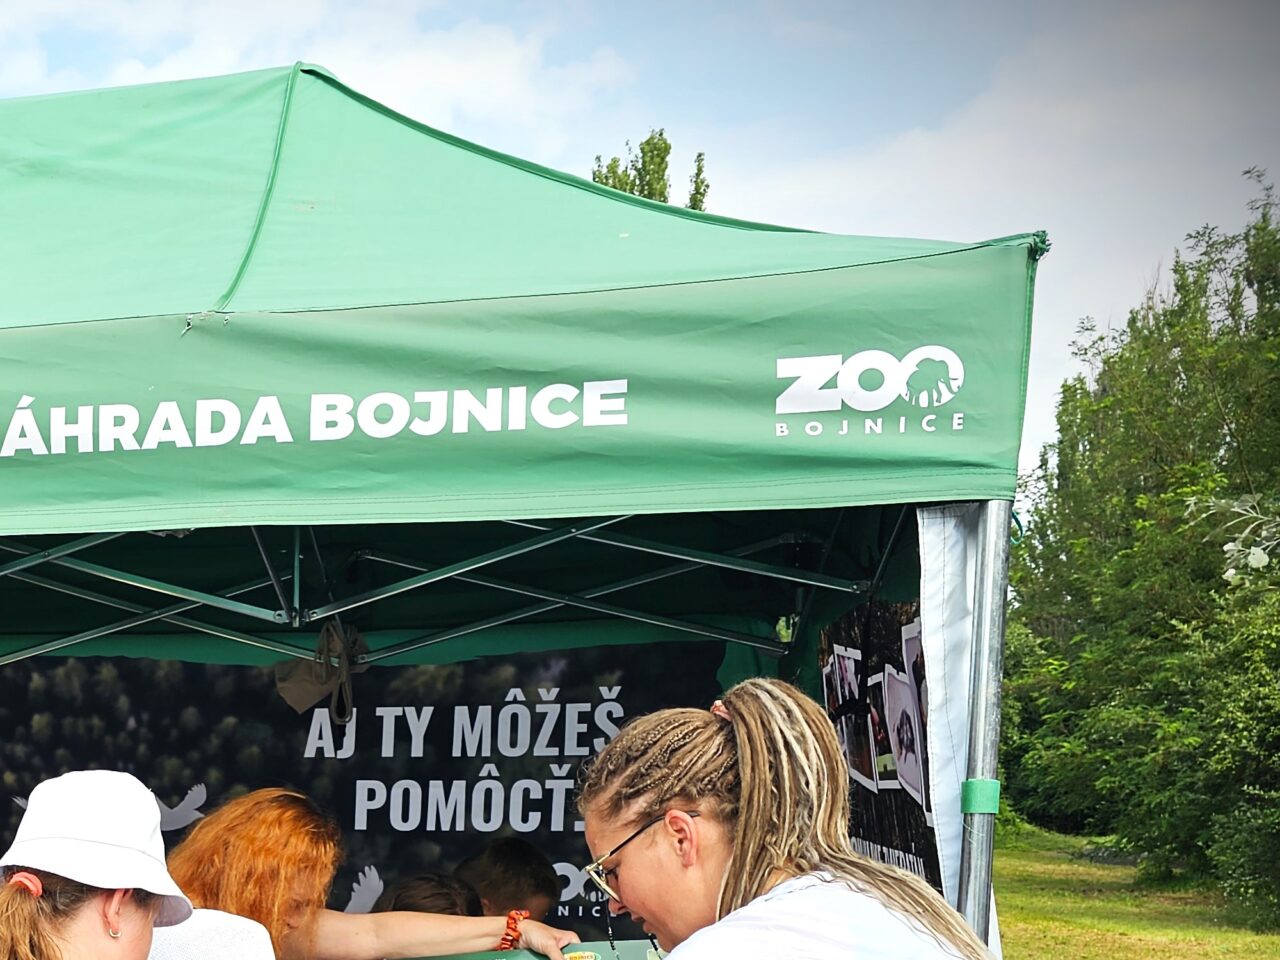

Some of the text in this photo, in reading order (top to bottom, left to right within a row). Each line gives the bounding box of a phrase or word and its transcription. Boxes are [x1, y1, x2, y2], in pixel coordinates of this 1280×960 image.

[309, 379, 628, 441] BOJNICE
[776, 345, 965, 414] ZOO
[775, 413, 964, 437] BOJNICE
[303, 685, 624, 759] AJ TY MÔŽEŠ
